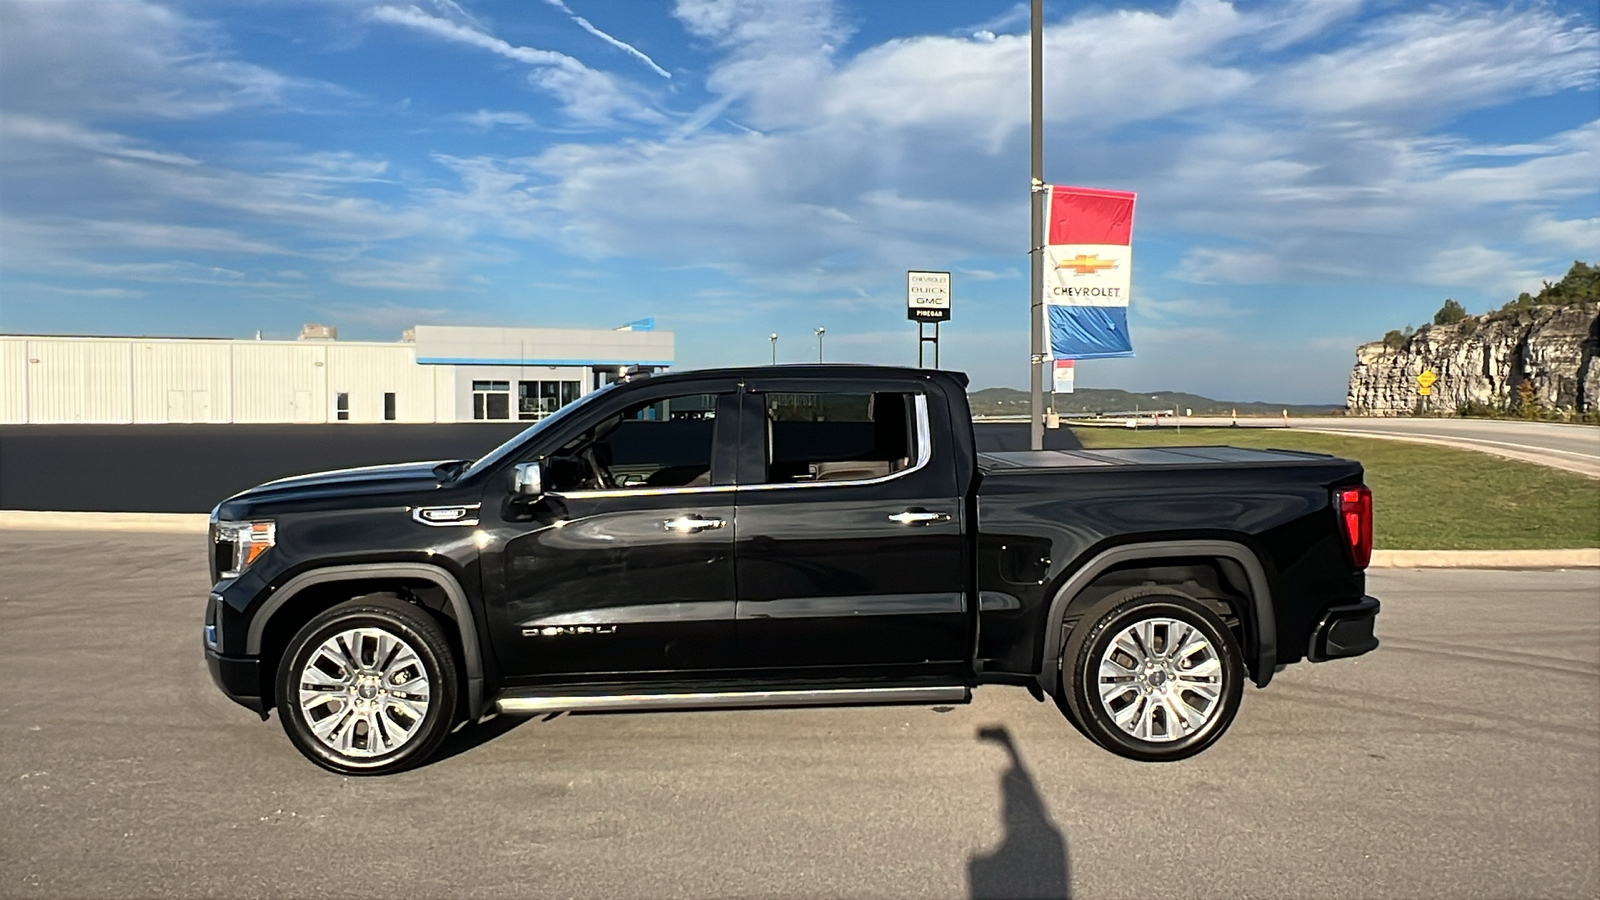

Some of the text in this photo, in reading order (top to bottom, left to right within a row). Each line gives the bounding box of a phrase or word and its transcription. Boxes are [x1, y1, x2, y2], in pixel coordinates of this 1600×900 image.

[911, 286, 947, 294] BUICK
[1053, 286, 1121, 297] CHEVROLET
[916, 297, 943, 305] GMC
